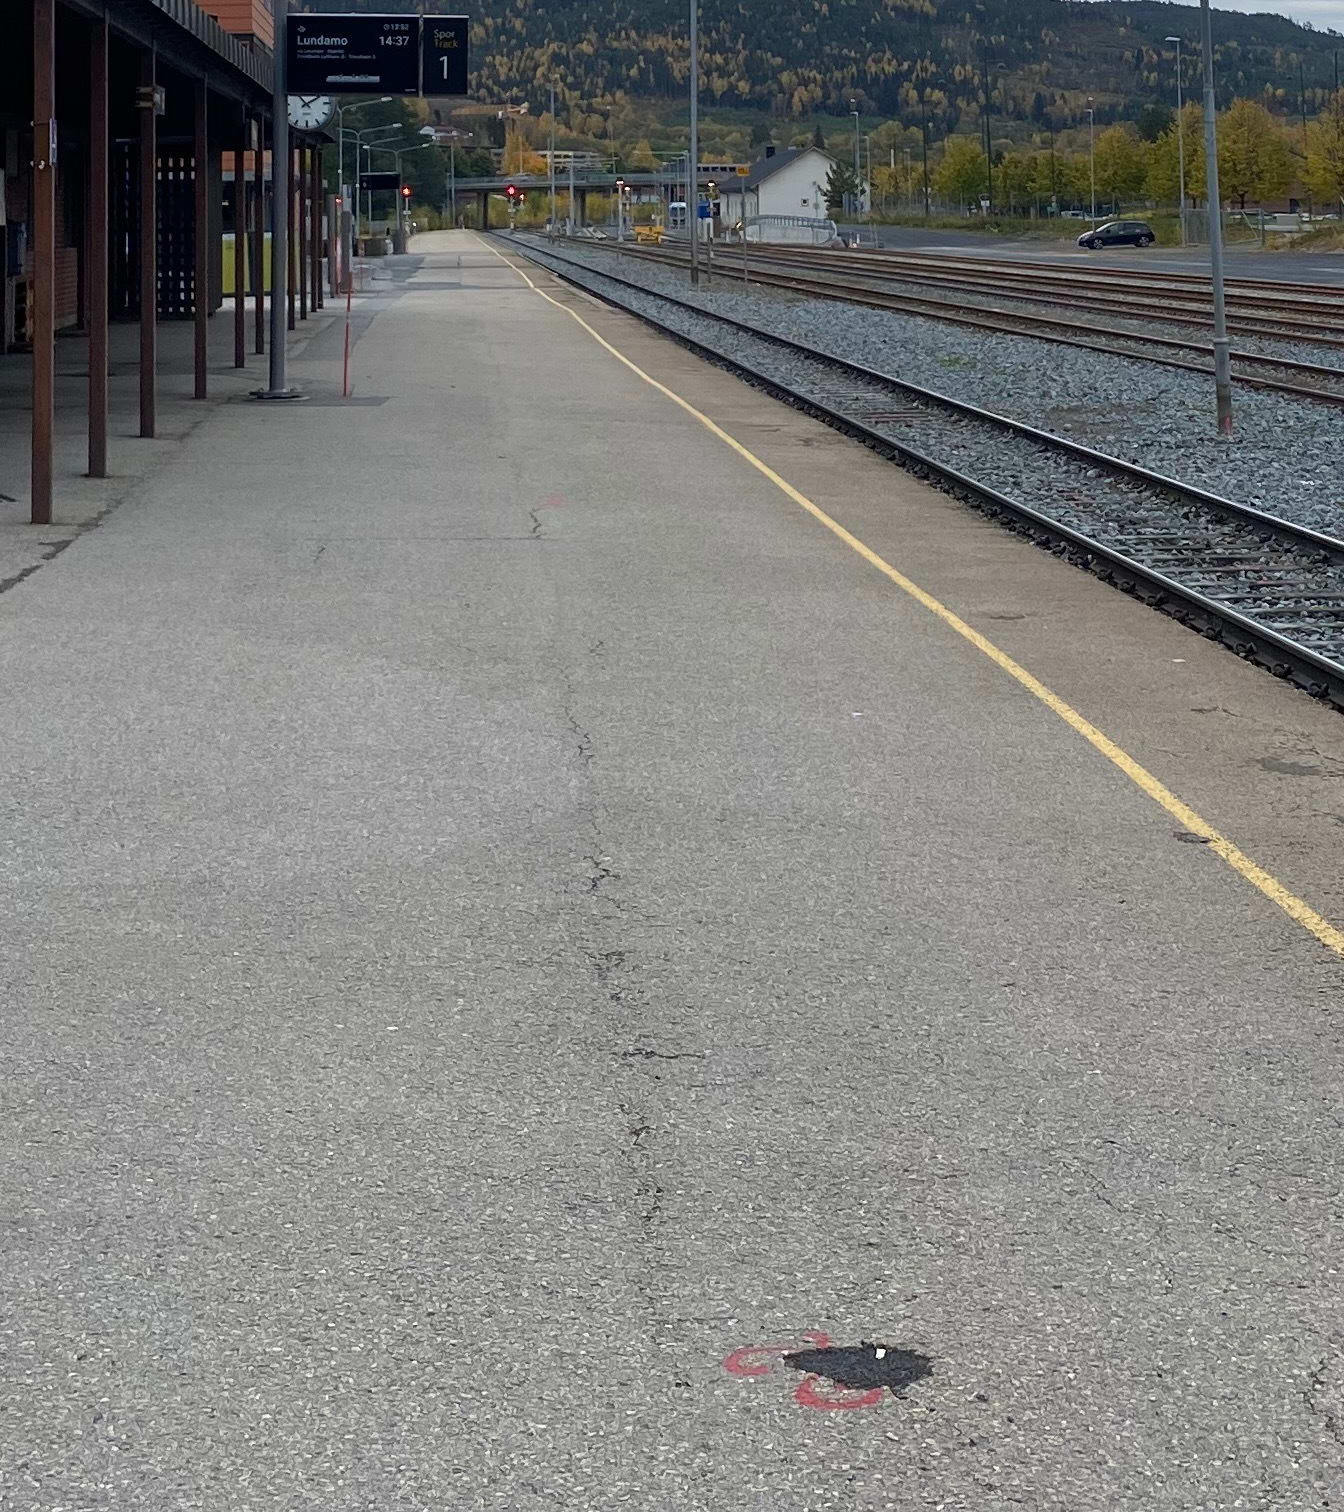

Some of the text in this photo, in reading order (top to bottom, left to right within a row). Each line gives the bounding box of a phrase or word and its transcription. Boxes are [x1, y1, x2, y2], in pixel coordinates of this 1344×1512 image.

[297, 34, 410, 46] Lundamo 14:37
[433, 29, 455, 40] Spor
[434, 39, 458, 48] Track
[439, 55, 448, 80] 1
